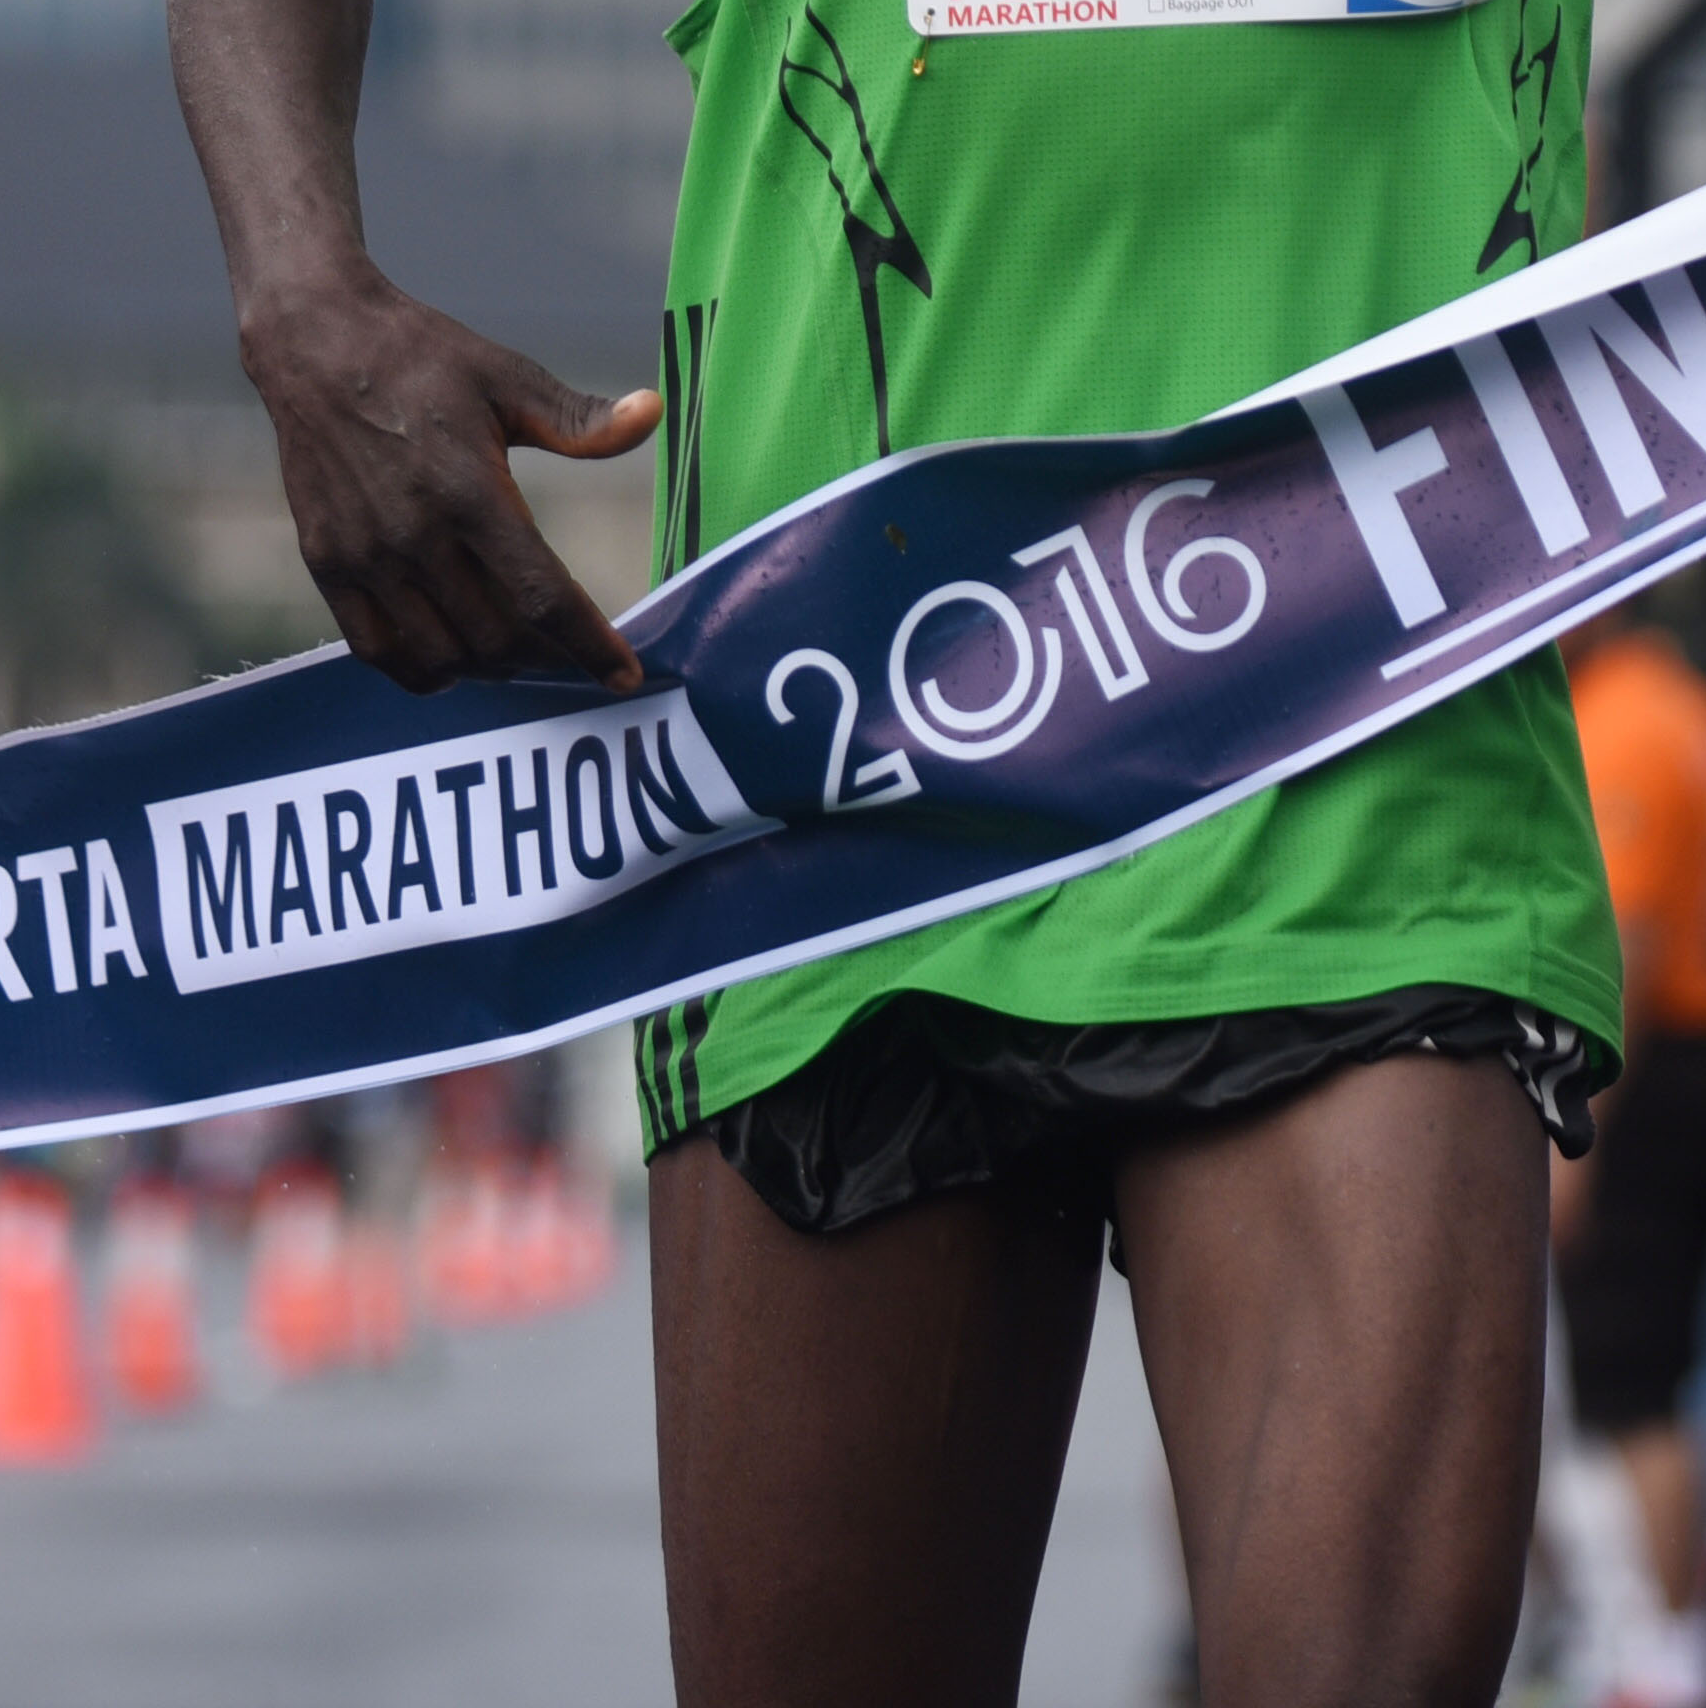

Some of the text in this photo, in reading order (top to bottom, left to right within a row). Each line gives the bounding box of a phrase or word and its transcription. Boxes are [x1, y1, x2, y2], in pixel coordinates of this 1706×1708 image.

[947, 0, 1118, 27] MARATHON
[180, 719, 724, 960] MARATHON
[765, 478, 1267, 815] 2016
